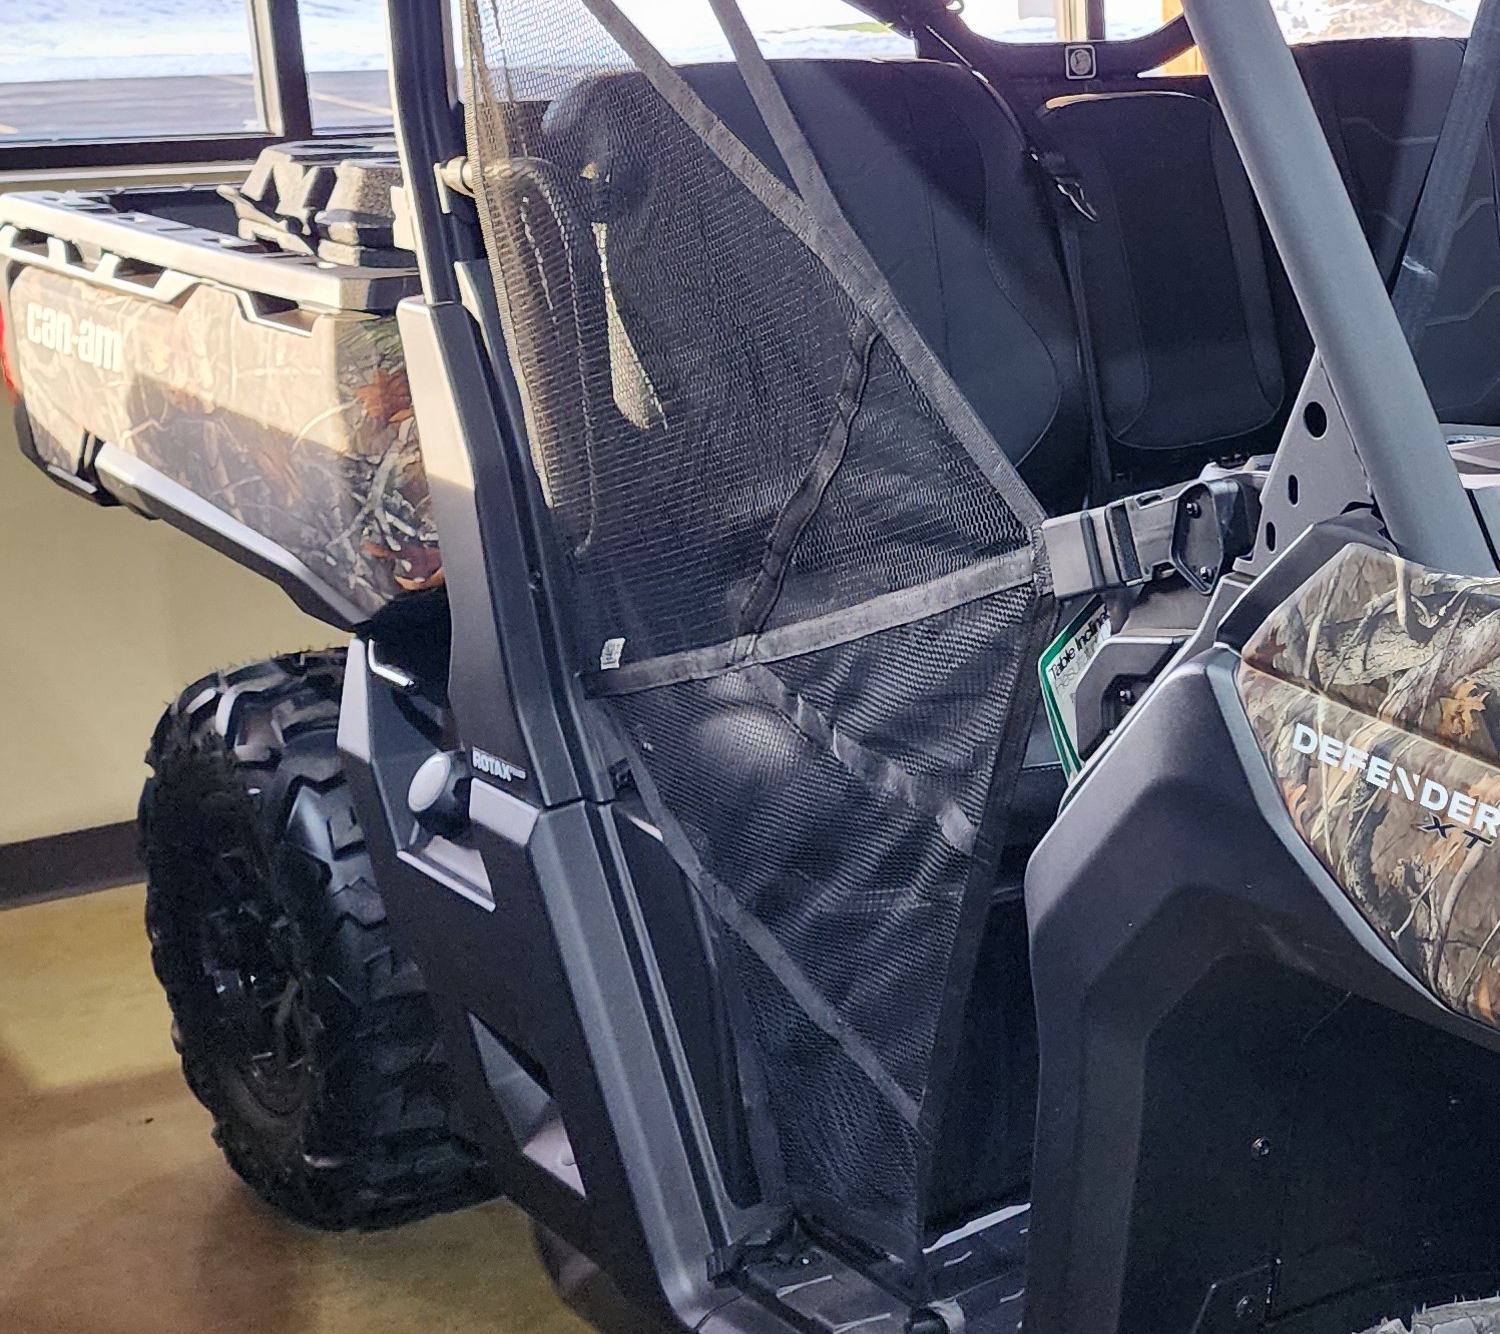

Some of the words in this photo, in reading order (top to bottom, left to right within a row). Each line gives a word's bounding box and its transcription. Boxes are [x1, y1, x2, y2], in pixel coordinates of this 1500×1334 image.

[27, 302, 121, 373] can-am
[1049, 647, 1076, 681] Table
[1417, 812, 1493, 850] XT
